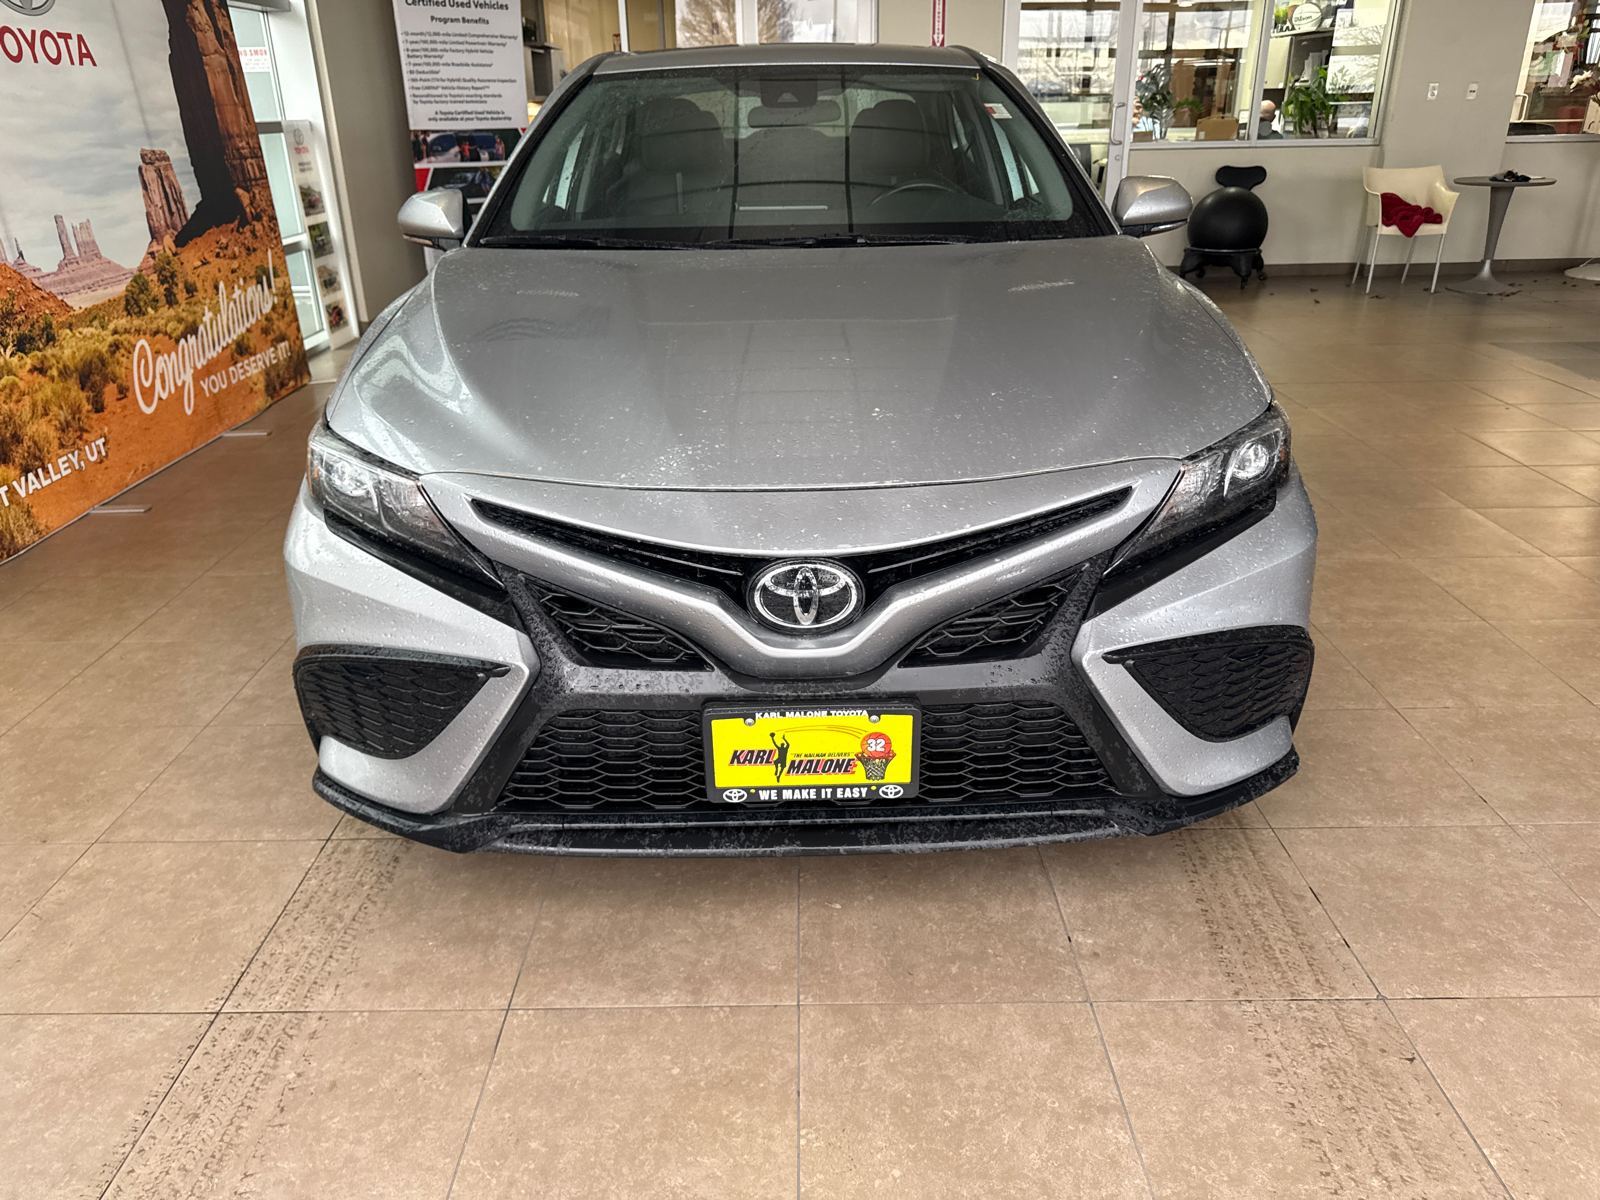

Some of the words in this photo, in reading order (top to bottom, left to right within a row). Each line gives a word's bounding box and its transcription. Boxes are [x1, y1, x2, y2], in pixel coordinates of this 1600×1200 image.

[449, 0, 472, 8] Used
[473, 0, 509, 10] Vehicles
[430, 15, 461, 24] Program
[462, 16, 490, 25] Benefits
[0, 25, 97, 67] OYOTA
[133, 248, 278, 415] Congratulations!
[200, 374, 228, 397] YOU
[228, 347, 277, 384] DESERVE
[276, 340, 292, 362] IT!
[12, 450, 86, 498] VALLEY,
[84, 437, 106, 462] UT
[866, 739, 886, 752] 32
[729, 749, 776, 766] KARL
[786, 758, 858, 776] MALONE
[759, 790, 778, 800] WE
[782, 788, 816, 799] MAKE
[821, 788, 832, 798] IT
[836, 787, 868, 798] EASY
